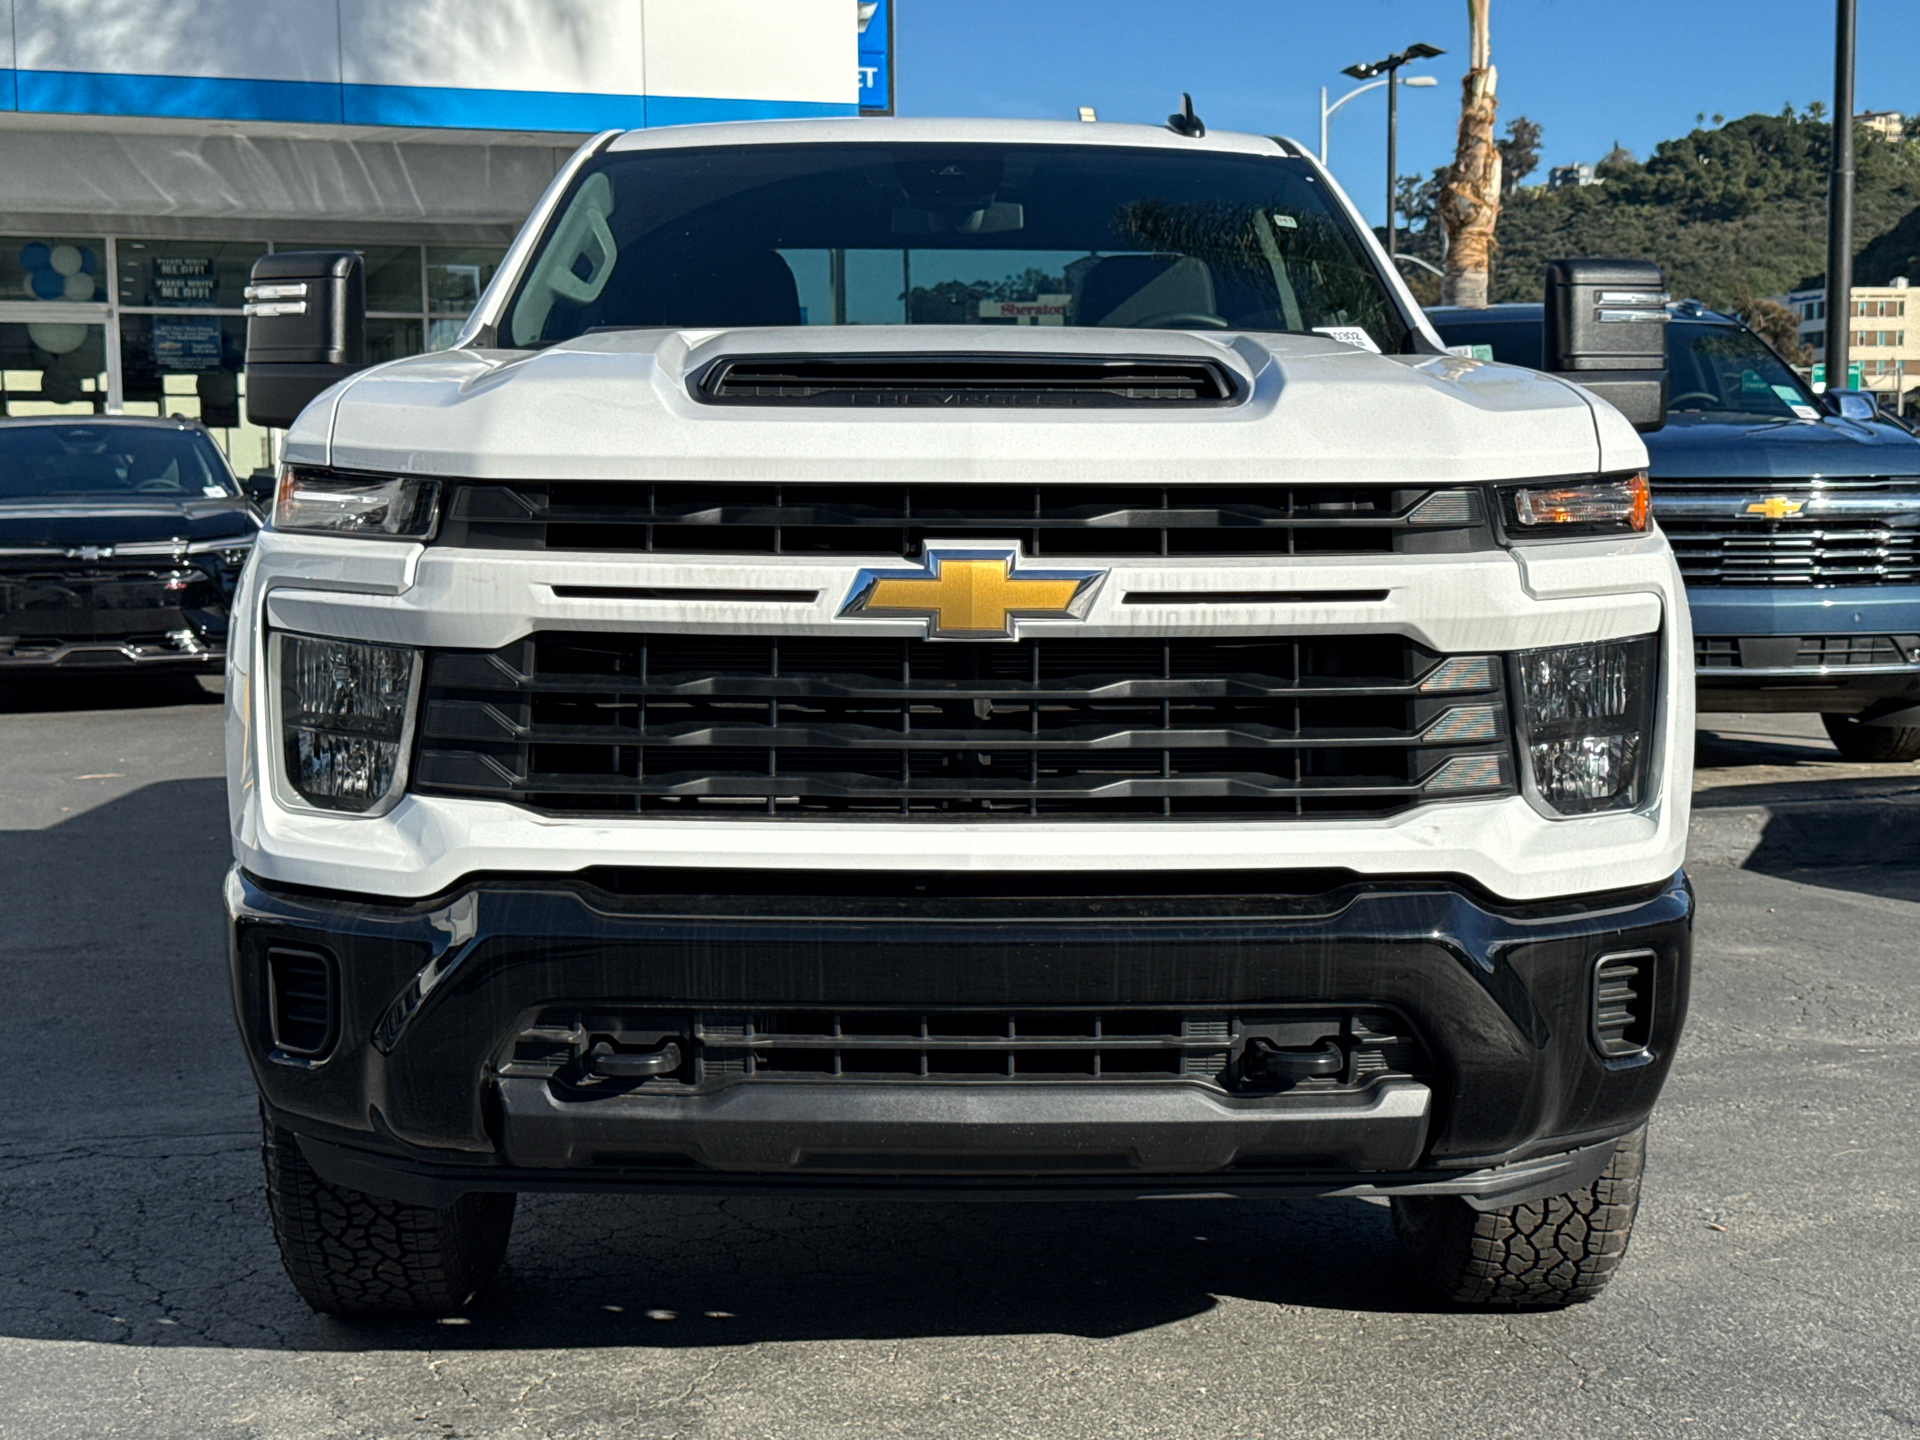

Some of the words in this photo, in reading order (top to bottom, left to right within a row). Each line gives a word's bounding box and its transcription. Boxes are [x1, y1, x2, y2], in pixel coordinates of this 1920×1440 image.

[162, 265, 178, 274] ME
[156, 280, 185, 288] PLEASE
[187, 280, 213, 288] WRITE
[162, 288, 179, 297] ME
[183, 288, 209, 298] OFF!
[851, 394, 1087, 405] CHEVROLET
